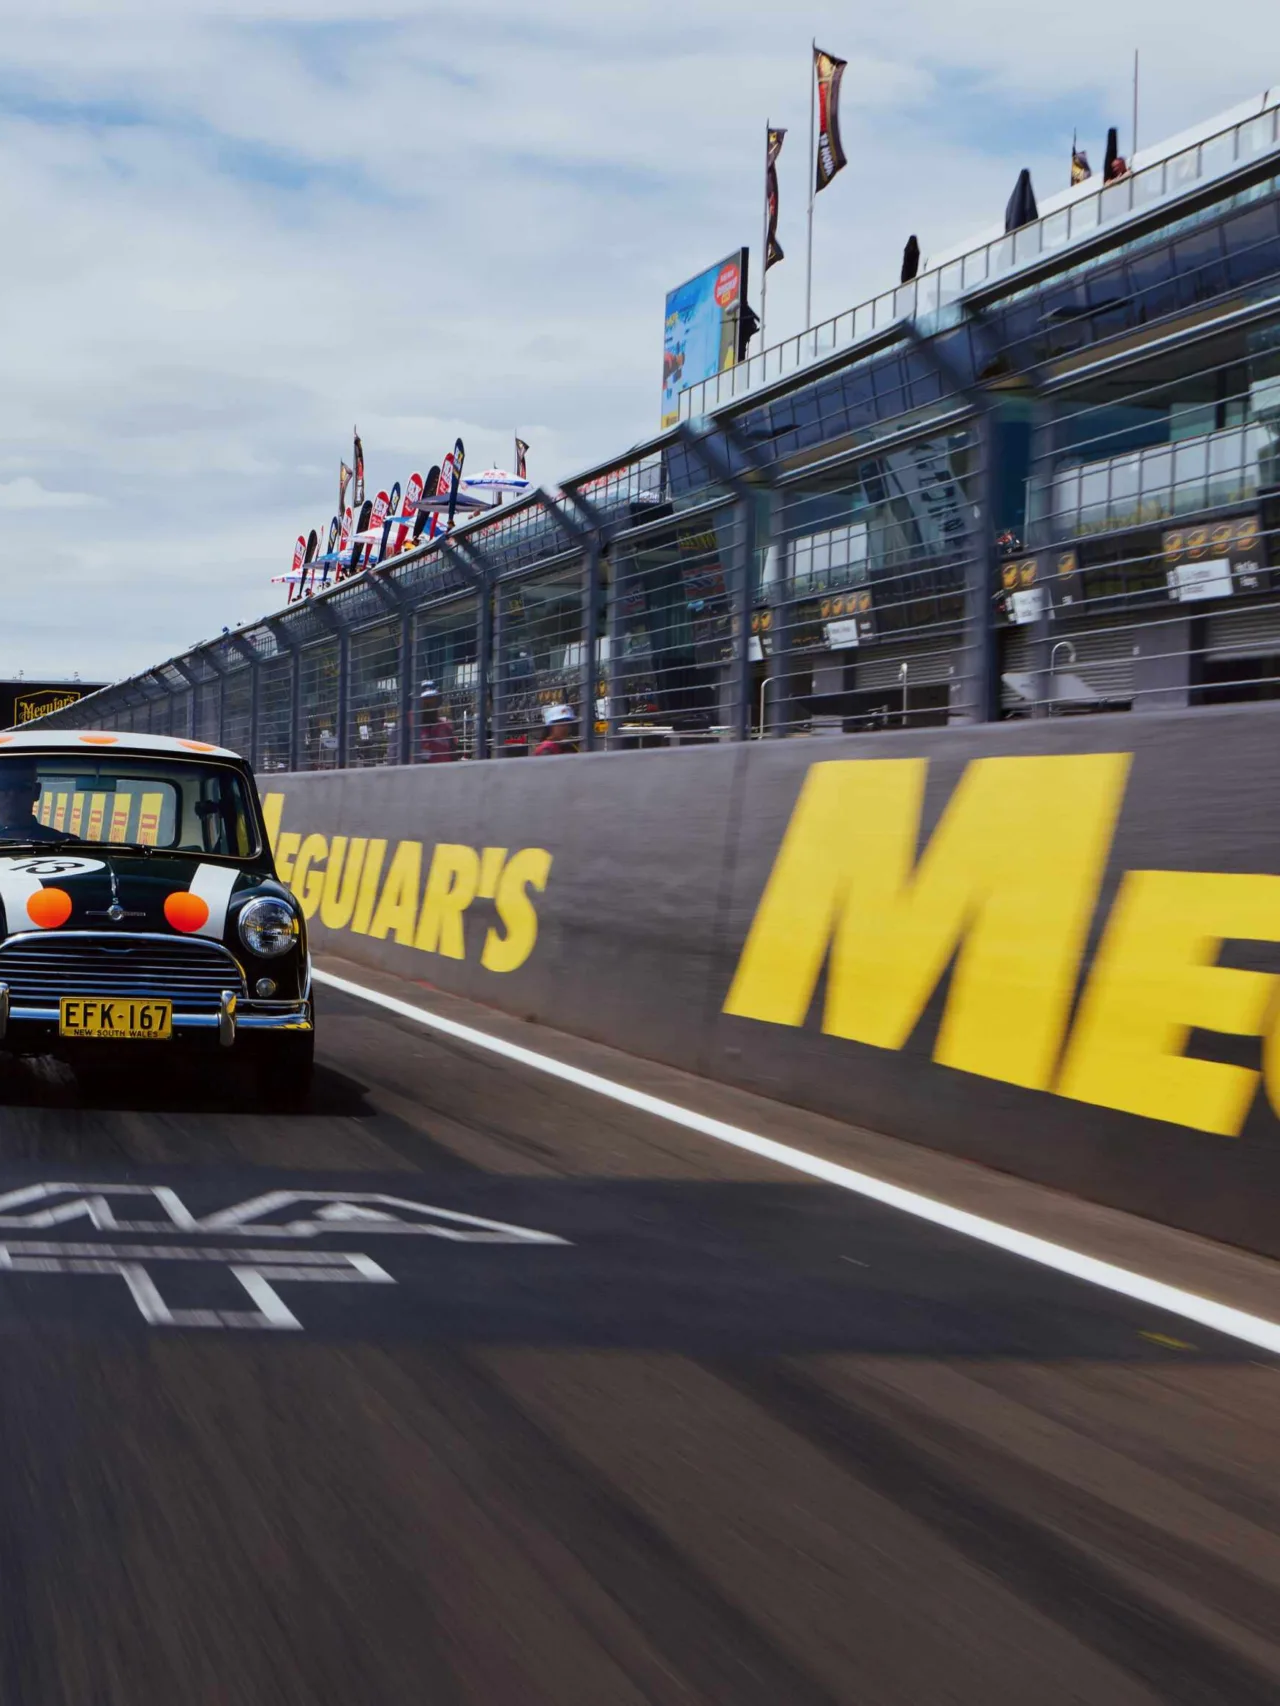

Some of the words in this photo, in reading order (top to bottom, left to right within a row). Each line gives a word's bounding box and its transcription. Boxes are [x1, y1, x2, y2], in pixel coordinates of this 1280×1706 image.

[256, 793, 554, 973] EGUIAR'S
[722, 752, 1280, 1137] ME
[128, 1030, 159, 1038] WALES
